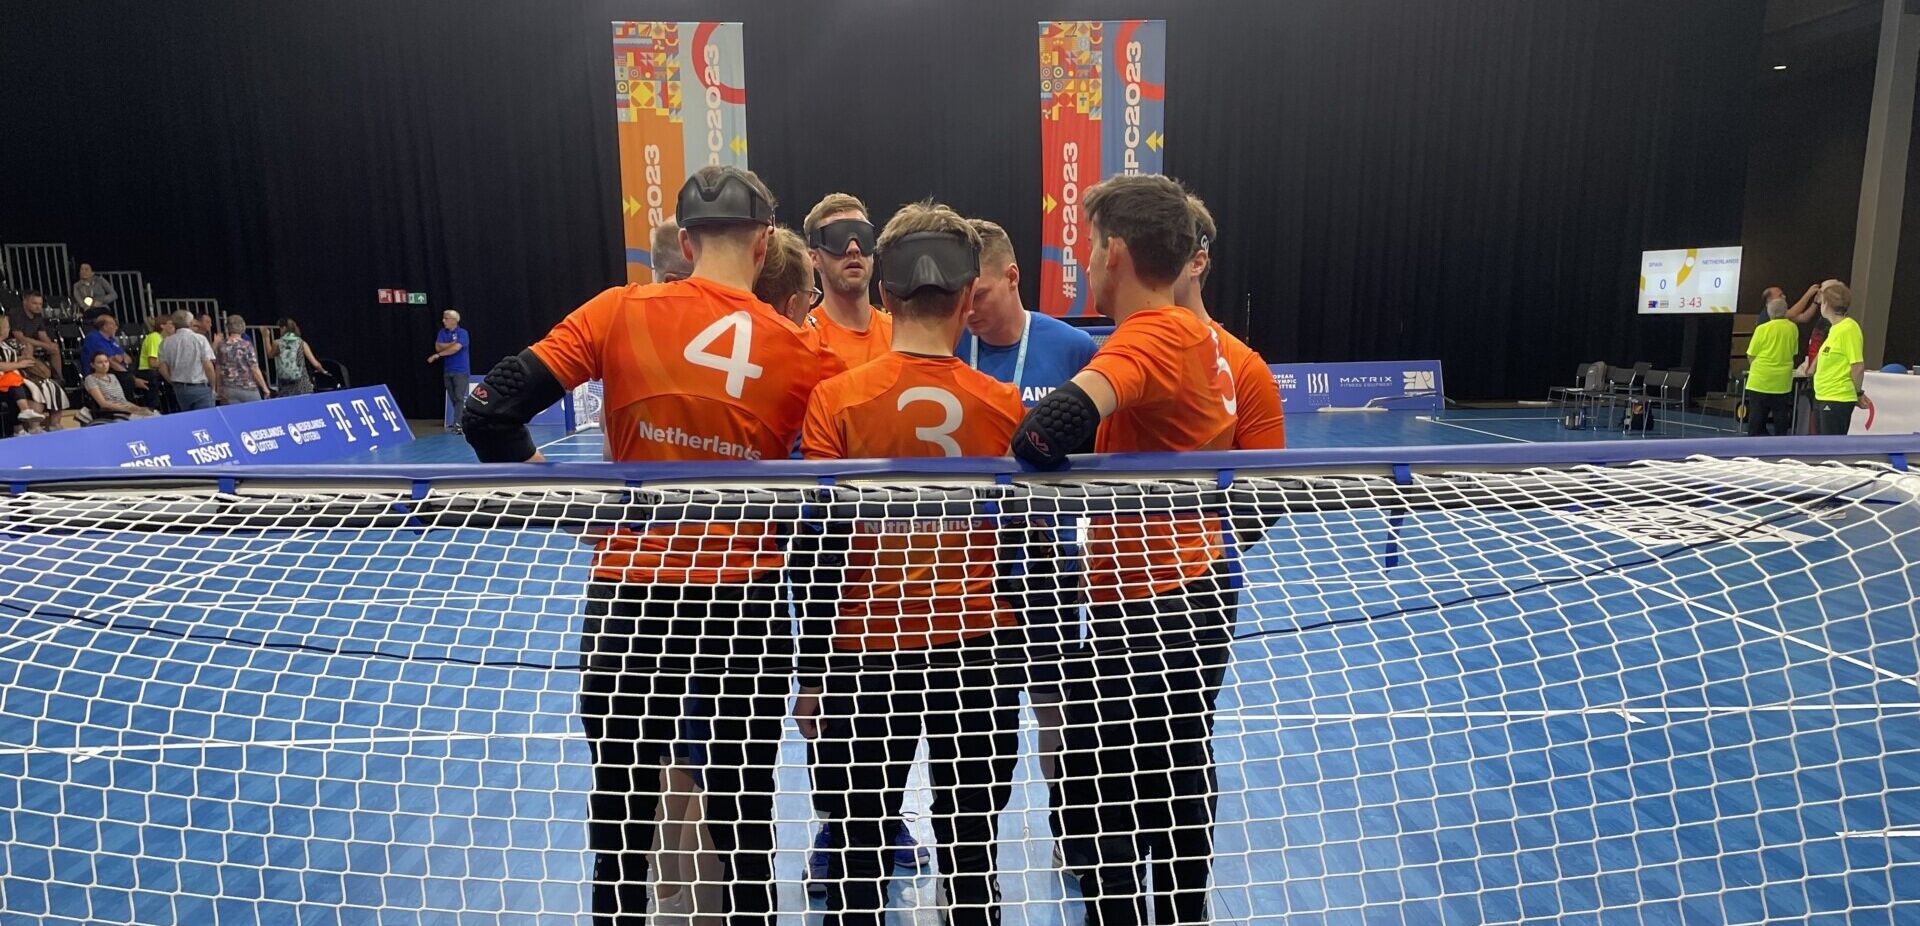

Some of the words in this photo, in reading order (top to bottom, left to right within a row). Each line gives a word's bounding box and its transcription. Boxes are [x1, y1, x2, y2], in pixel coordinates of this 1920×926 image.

[1062, 142, 1079, 299] #EPC2023
[1660, 279, 1666, 290] 0
[1714, 277, 1721, 288] 0
[1680, 297, 1702, 308] 3:43
[683, 310, 763, 399] 4
[897, 386, 963, 457] 3
[639, 420, 762, 460] Netherlands
[121, 454, 171, 467] SOT
[187, 442, 233, 465] TISSOT
